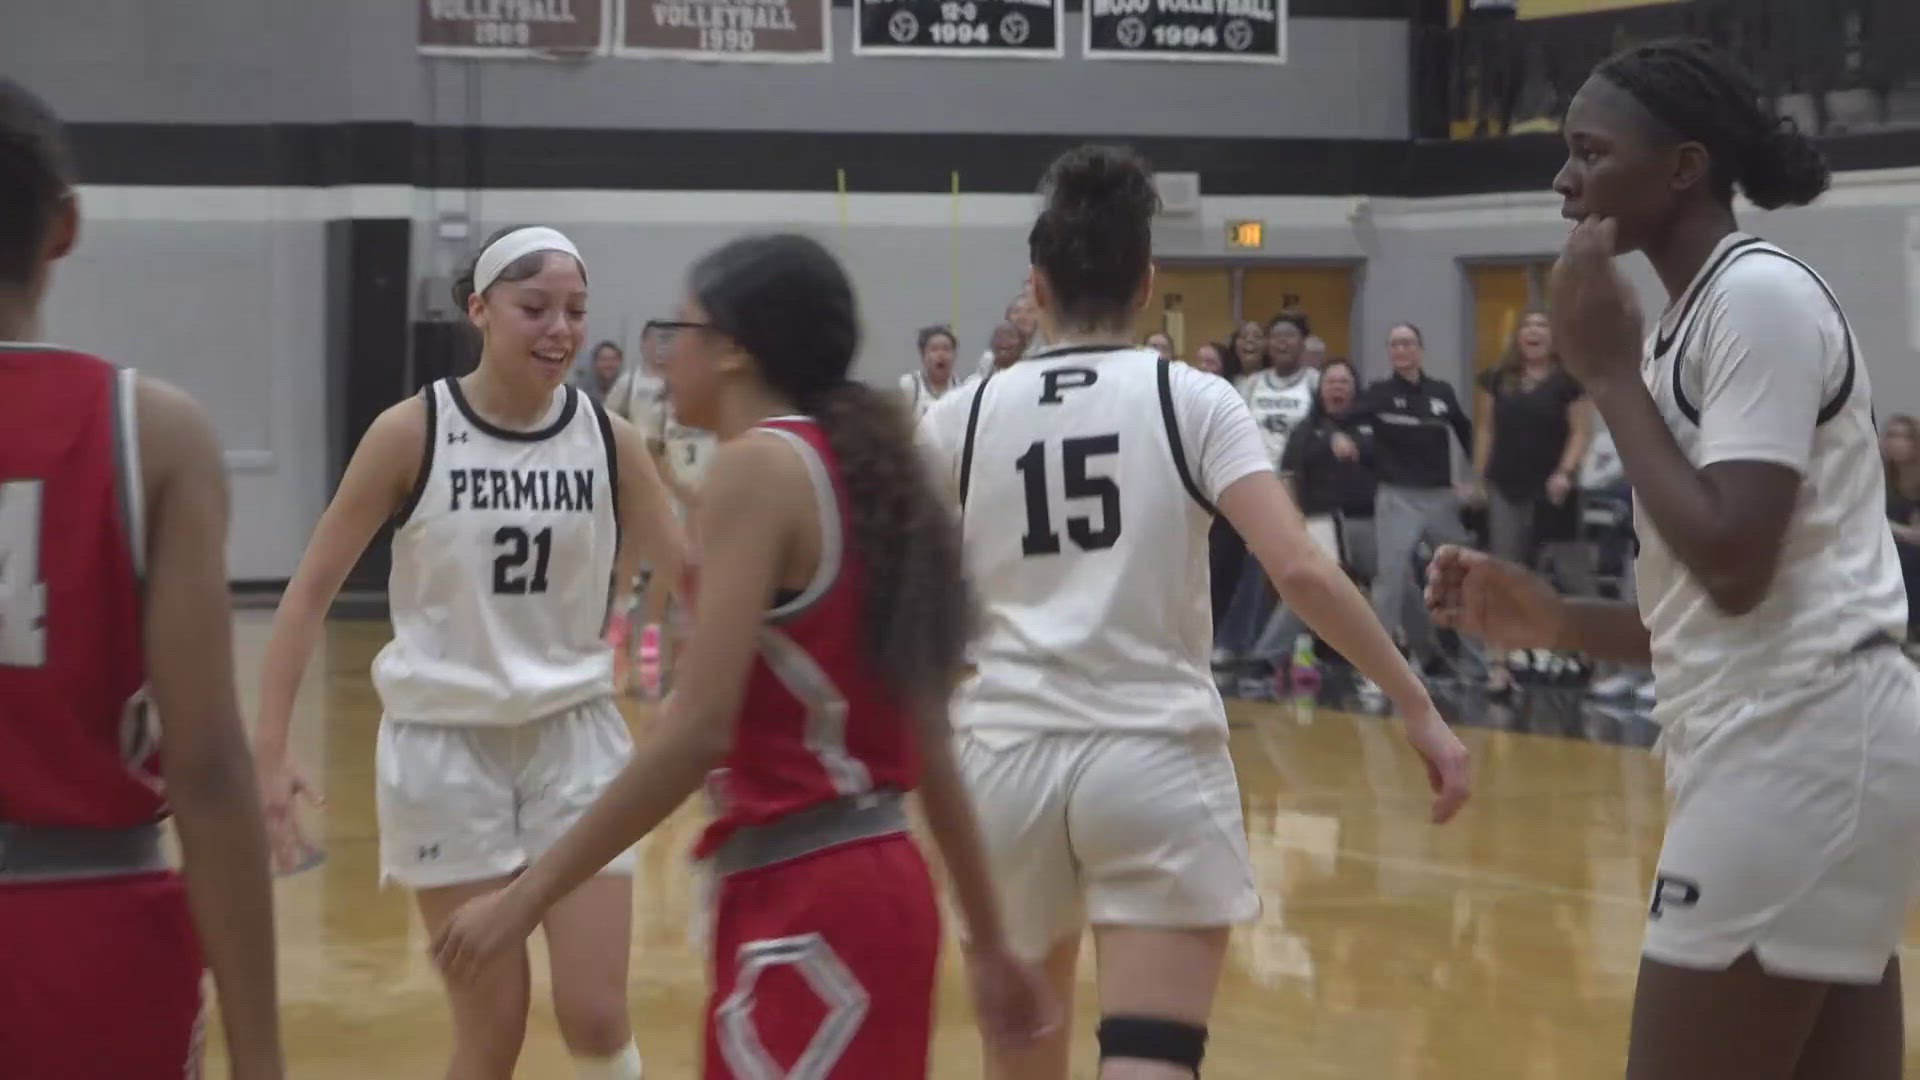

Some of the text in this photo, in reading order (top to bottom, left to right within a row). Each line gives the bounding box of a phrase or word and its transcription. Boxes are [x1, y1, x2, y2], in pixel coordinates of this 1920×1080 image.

[652, 3, 797, 31] VOLLEYBALL
[699, 29, 755, 52] 1990
[1038, 366, 1098, 405] P
[450, 468, 594, 511] PERMIAN
[1015, 432, 1122, 557] 15
[493, 526, 552, 594] 21
[1649, 875, 1701, 920] P
